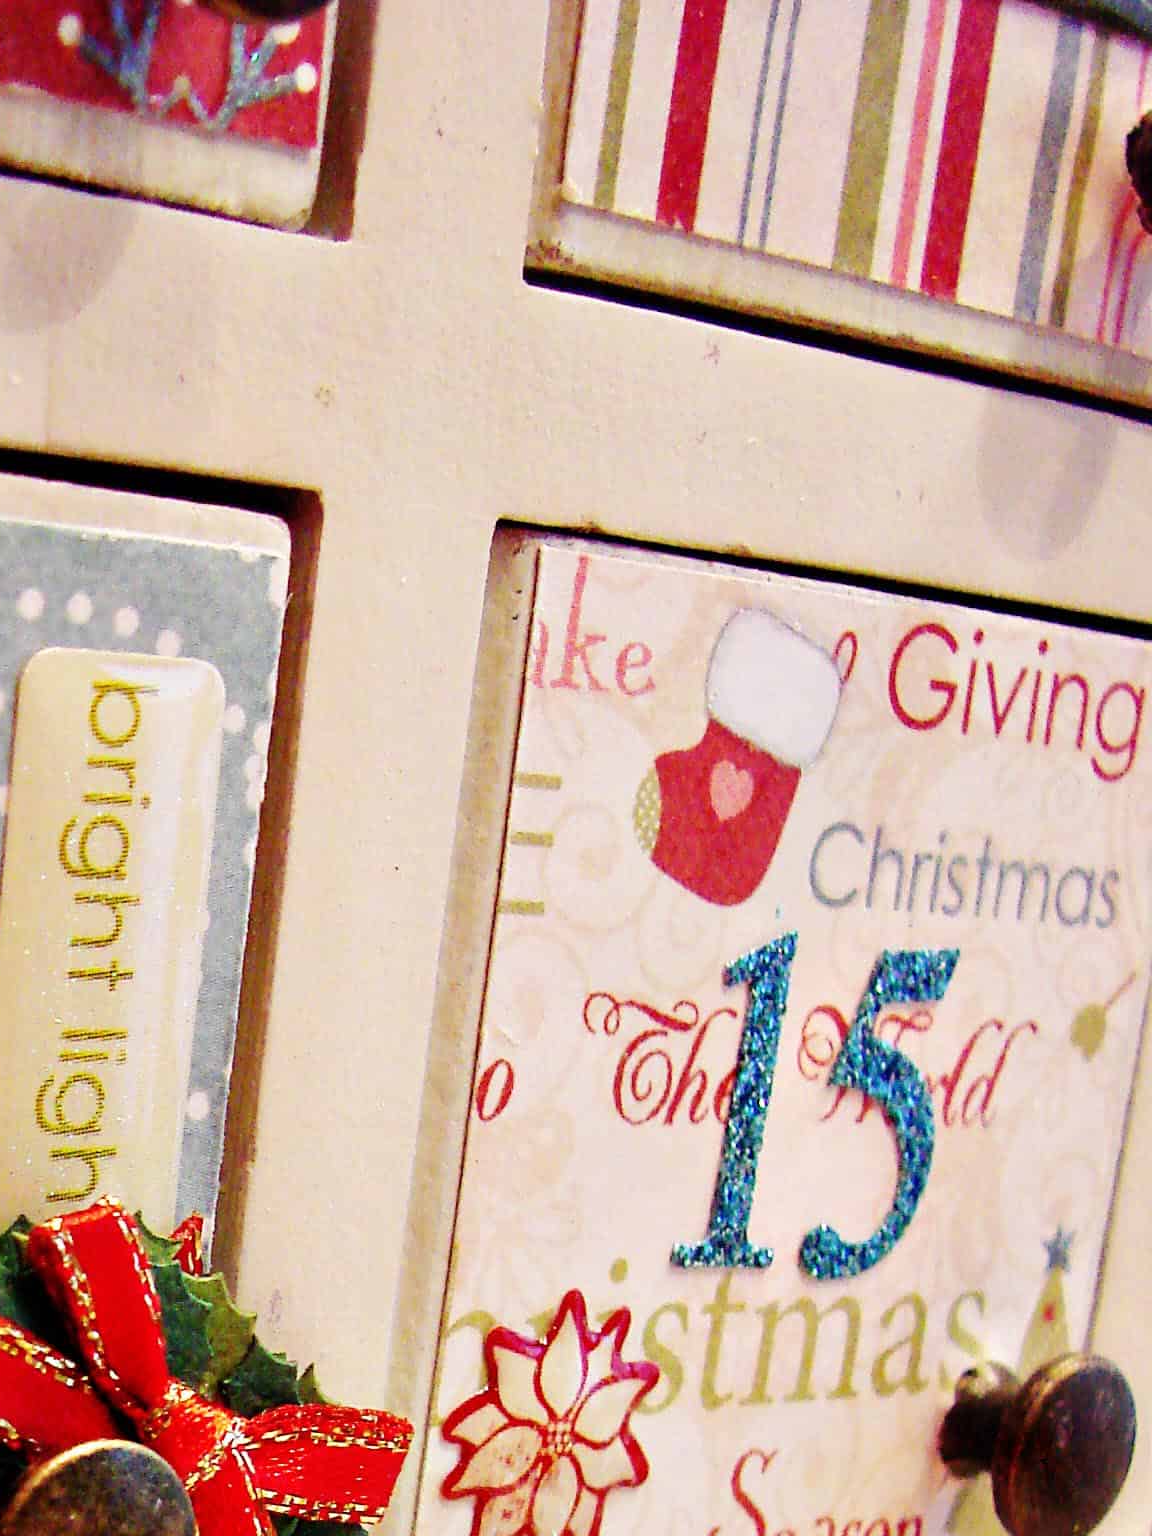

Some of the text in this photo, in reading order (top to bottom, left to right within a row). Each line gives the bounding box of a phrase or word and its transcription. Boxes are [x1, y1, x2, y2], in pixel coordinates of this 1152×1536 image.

[888, 622, 1146, 783] Giving
[57, 678, 160, 992] bright
[808, 820, 1120, 929] Christmas
[669, 929, 960, 1281] 15
